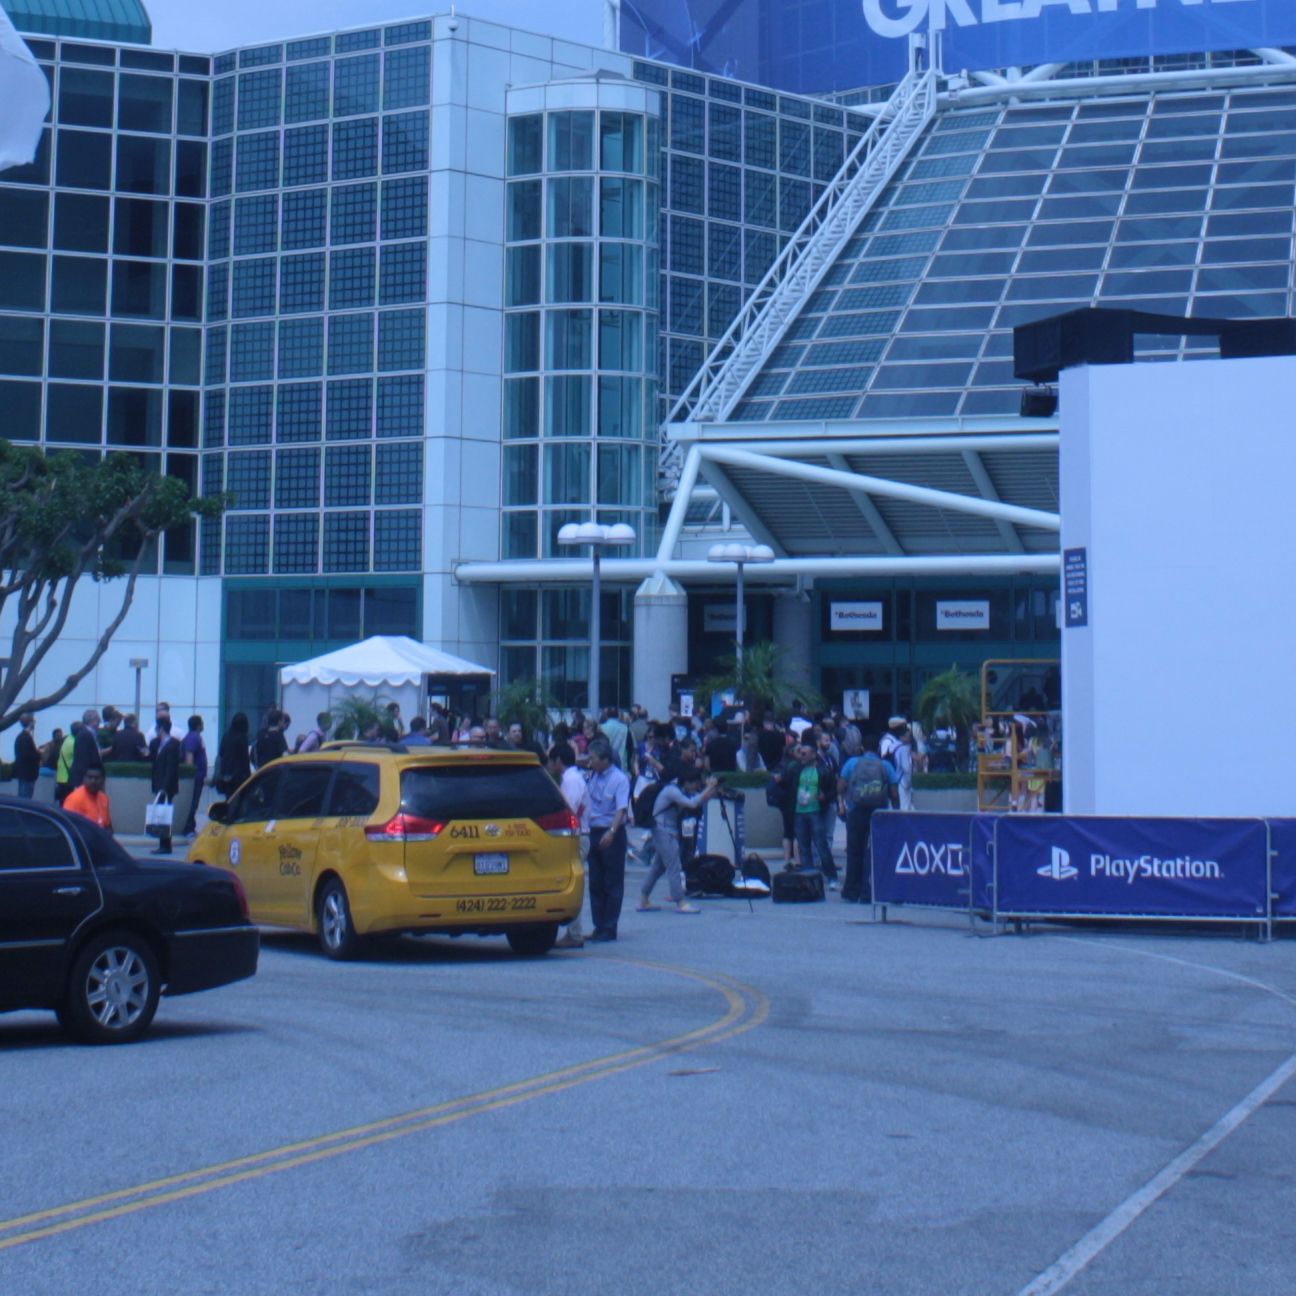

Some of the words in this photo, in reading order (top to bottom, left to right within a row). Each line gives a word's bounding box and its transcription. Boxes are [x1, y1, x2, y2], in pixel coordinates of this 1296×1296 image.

[944, 609, 984, 618] Bethesda
[450, 824, 480, 839] 6411
[1090, 854, 1221, 885] PlayStation
